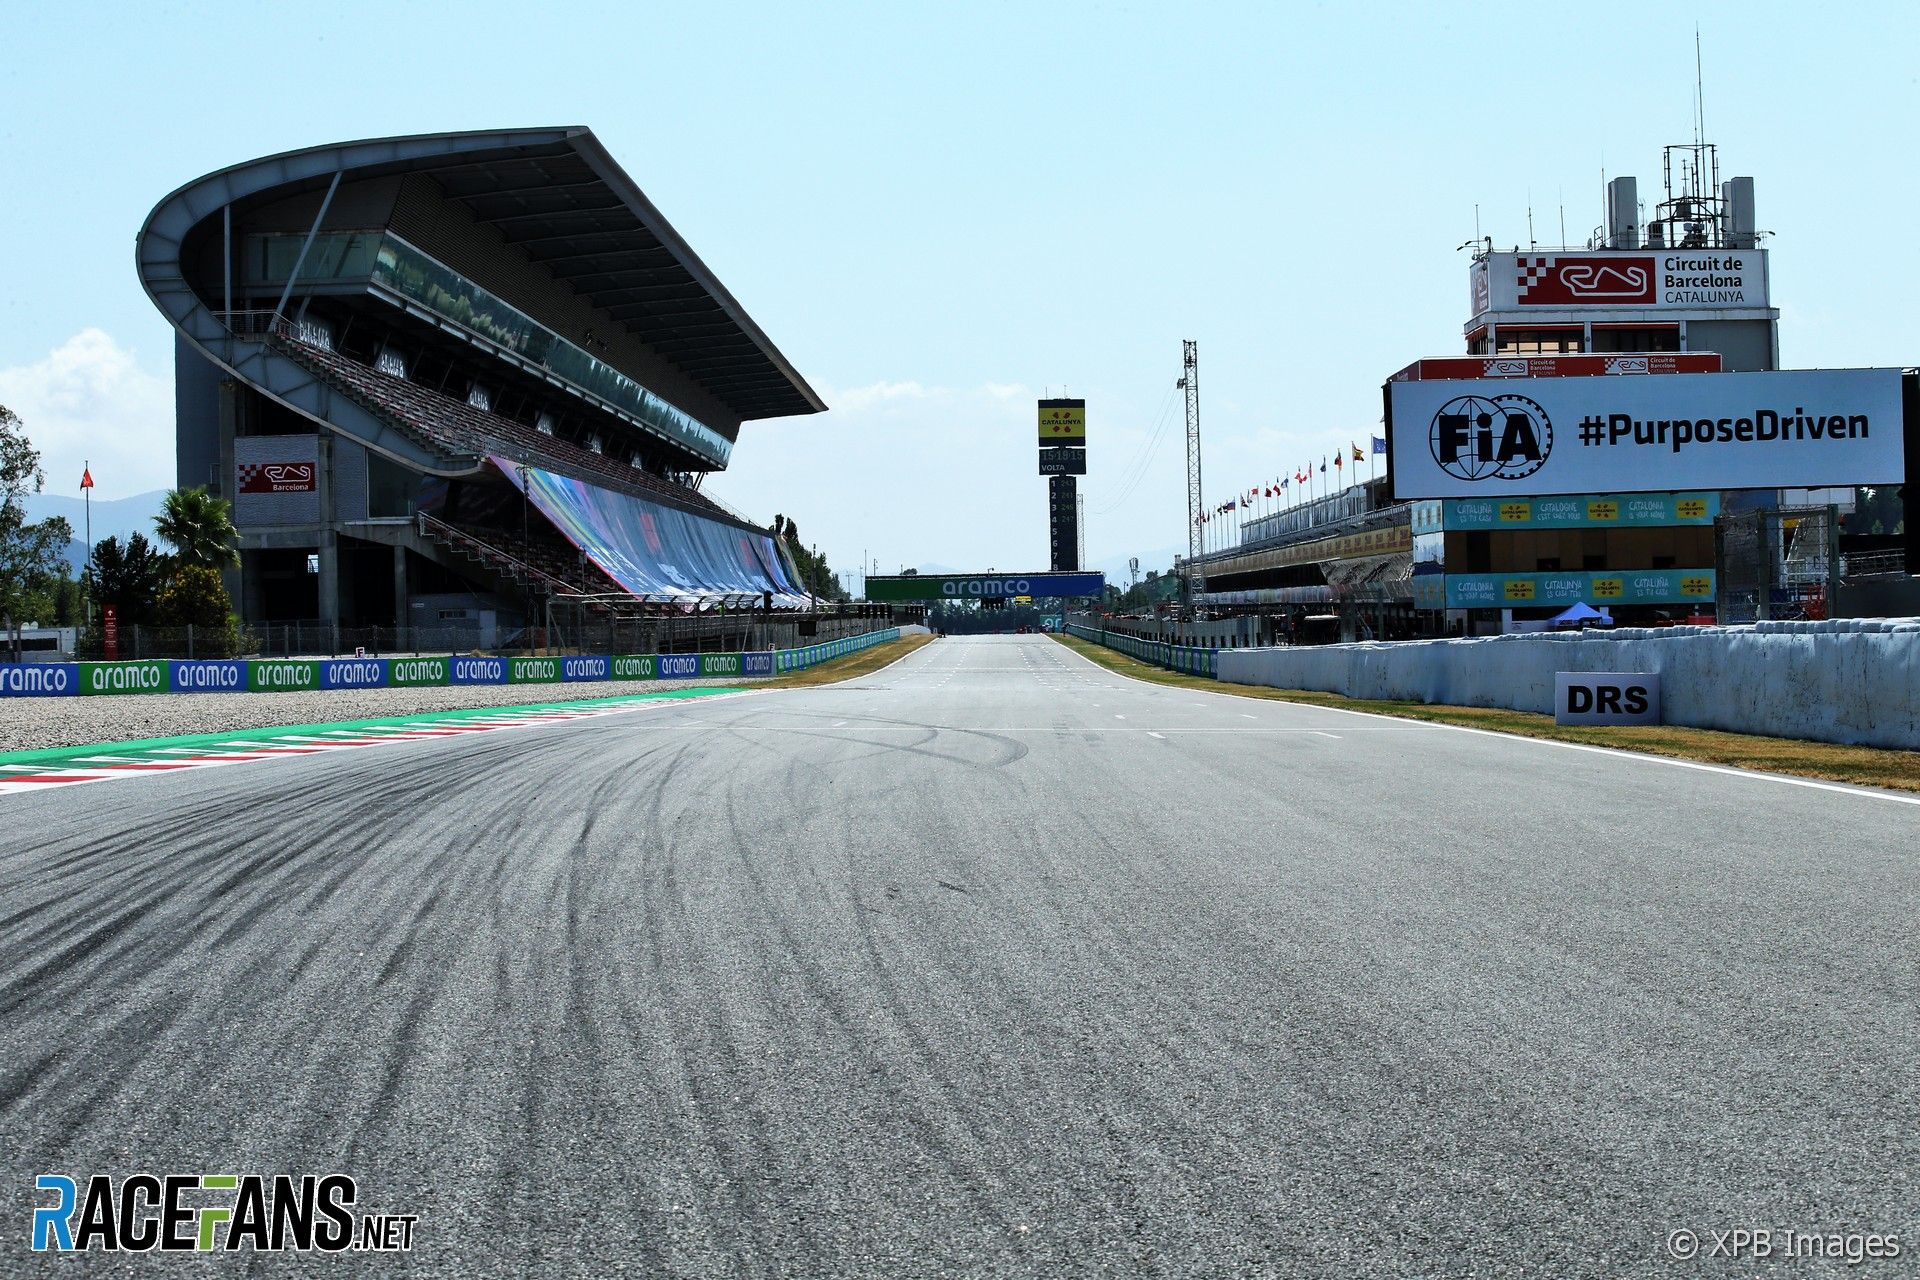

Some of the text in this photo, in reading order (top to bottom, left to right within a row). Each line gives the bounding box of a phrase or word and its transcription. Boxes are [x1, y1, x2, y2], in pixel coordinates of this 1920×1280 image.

[1664, 256, 1743, 271] Circuit de
[1665, 274, 1742, 288] Barcelona
[1665, 291, 1744, 303] CATALUNYA
[1579, 407, 1869, 453] #PurposeDriven
[942, 580, 1030, 595] aramco
[395, 661, 443, 680] aramco
[456, 661, 500, 679] aramco
[515, 661, 555, 678] aramco
[566, 660, 605, 677] aramco
[615, 659, 651, 675] aramco
[662, 657, 696, 674] aramco
[705, 656, 737, 672] aramco
[746, 656, 769, 670] aramco
[0, 668, 67, 691] ramco
[93, 666, 160, 689] aramco
[178, 665, 238, 686] aramco
[257, 665, 311, 685] aramco
[330, 663, 380, 683] aramco
[1568, 686, 1648, 714] DRS
